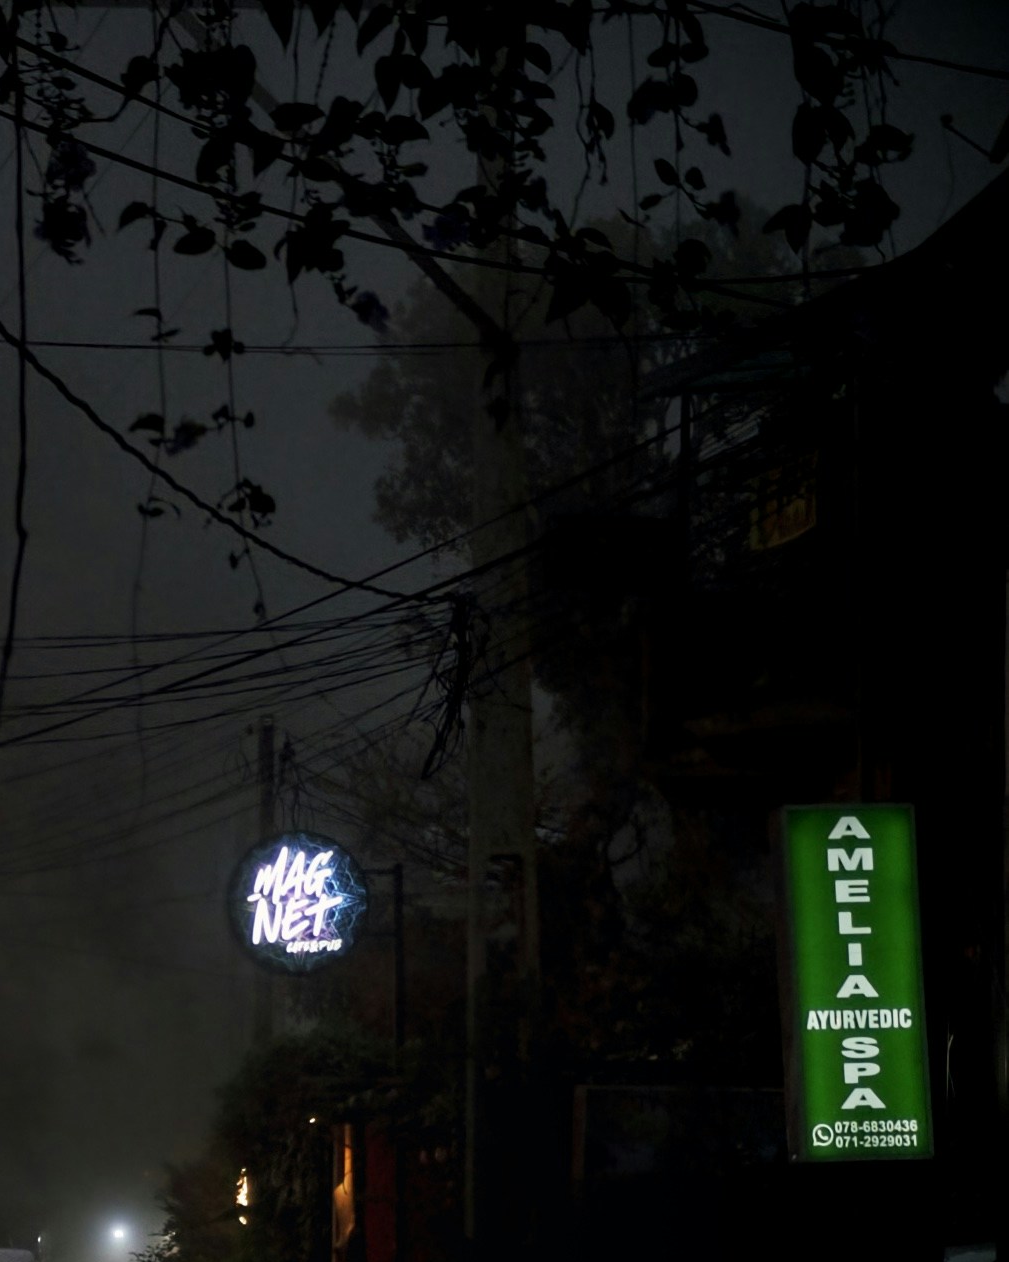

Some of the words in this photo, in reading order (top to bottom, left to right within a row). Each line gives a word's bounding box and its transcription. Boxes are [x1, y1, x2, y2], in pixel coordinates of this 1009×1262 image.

[254, 846, 333, 904] MAG
[247, 894, 343, 945] NET
[827, 816, 879, 998] AMELIA
[807, 1008, 912, 1030] AYURVEDIC
[841, 1037, 886, 1109] SPA
[835, 1120, 918, 1133] 078-6830436
[835, 1134, 918, 1148] 071-2929031
